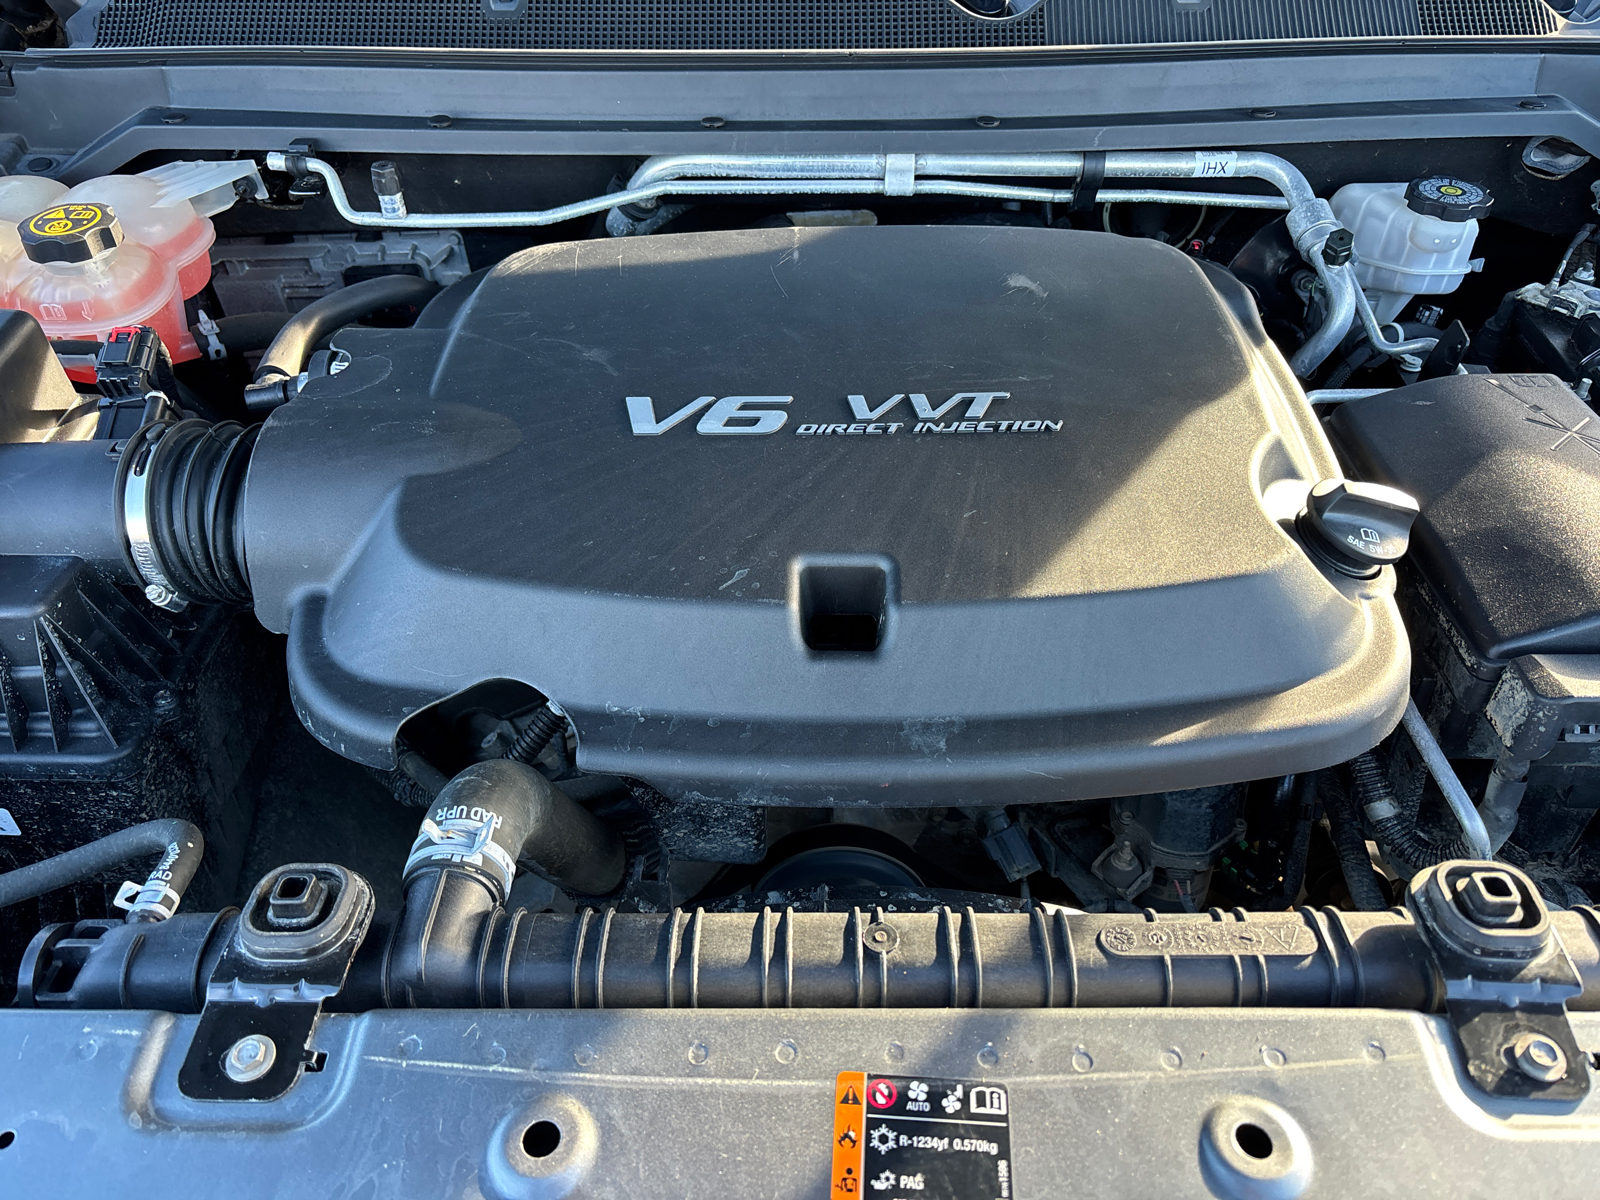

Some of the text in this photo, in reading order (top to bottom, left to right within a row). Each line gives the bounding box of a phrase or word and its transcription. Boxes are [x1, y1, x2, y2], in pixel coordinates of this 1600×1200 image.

[1201, 161, 1229, 175] IHX
[625, 395, 794, 436] V6
[847, 391, 1011, 421] VVT
[795, 418, 1064, 436] DIRECT INJECTION
[1346, 535, 1397, 555] SAE 5W-30
[435, 805, 504, 829] RAD UPR
[148, 870, 173, 881] RAD
[906, 1101, 931, 1112] AUTO
[899, 1134, 999, 1155] R-1234yf 0.570kg
[899, 1175, 925, 1190] PAG
